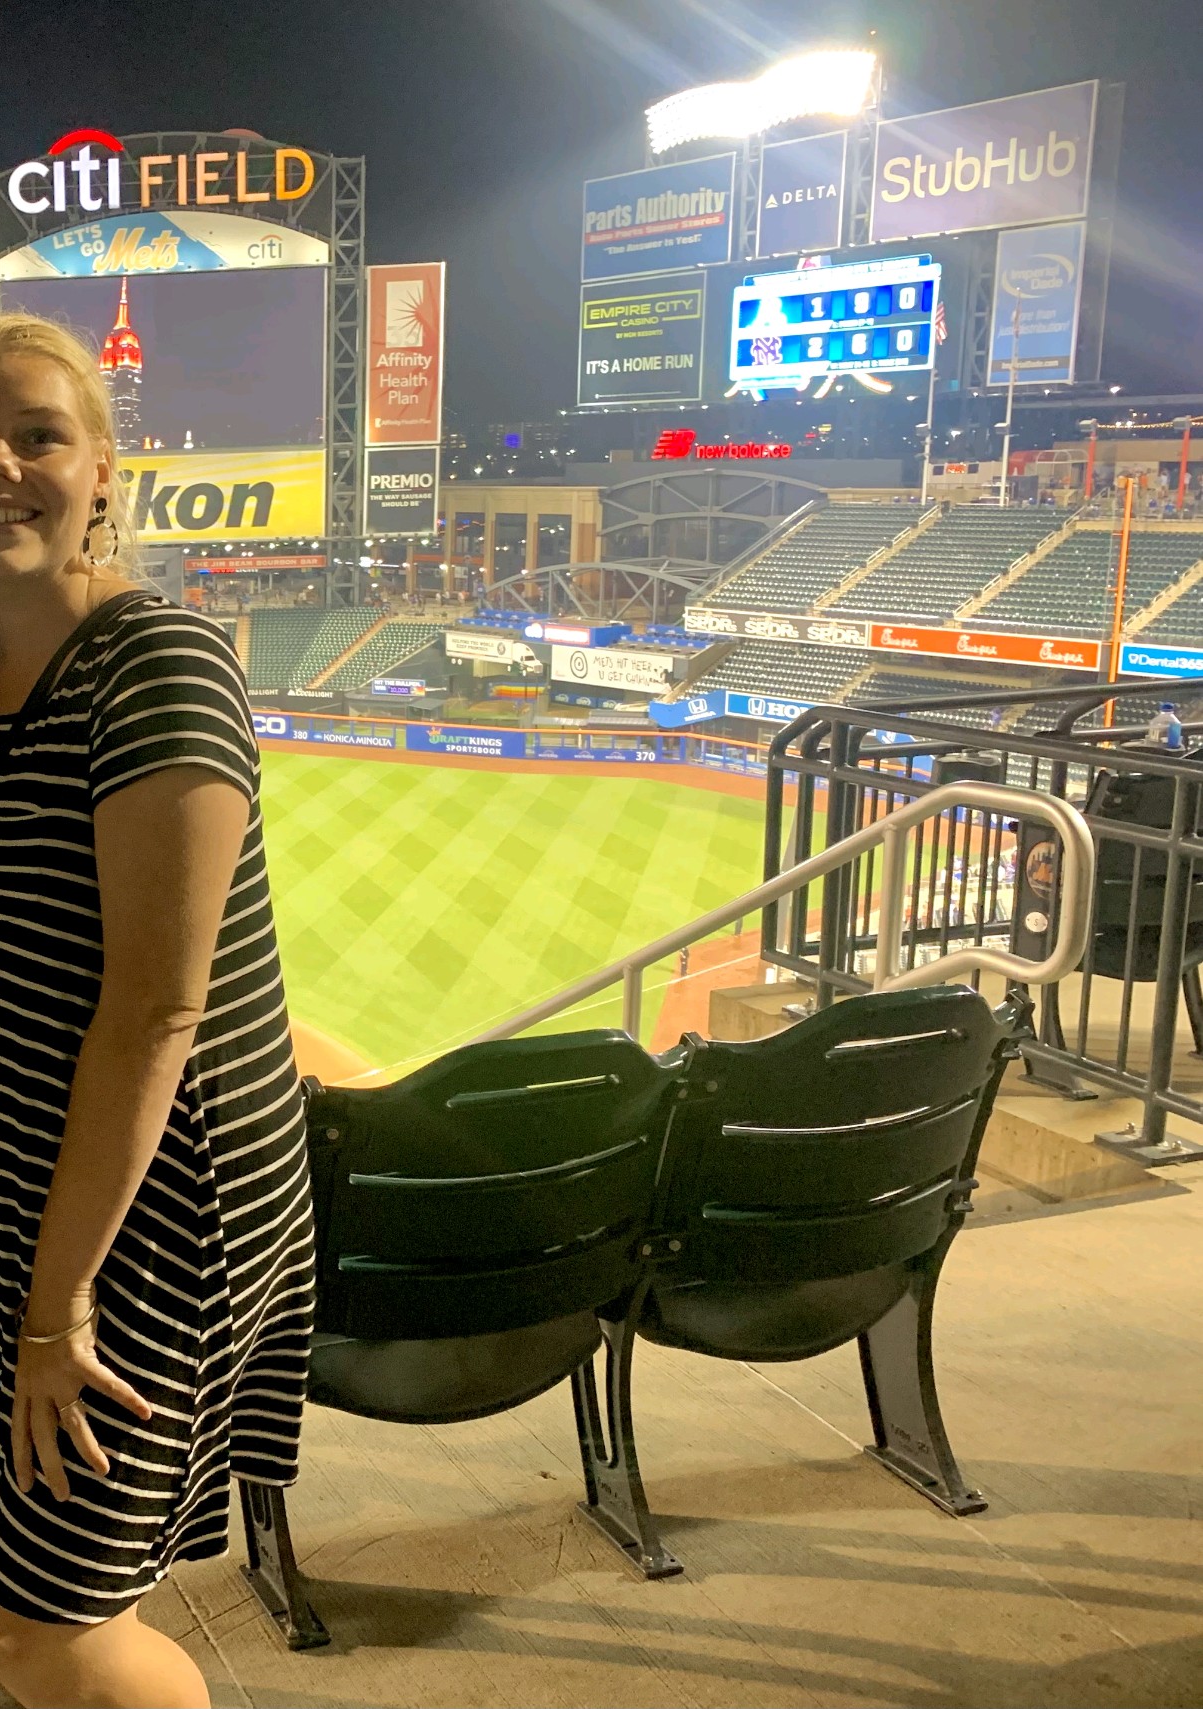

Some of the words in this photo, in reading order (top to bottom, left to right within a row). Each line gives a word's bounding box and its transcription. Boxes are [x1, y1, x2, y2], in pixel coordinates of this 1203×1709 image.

[881, 131, 1076, 203] StubHub
[8, 145, 120, 214] citi
[140, 148, 315, 208] FIELD
[782, 184, 837, 205] DELTA
[585, 204, 632, 233] Parts
[635, 187, 726, 225] Authority
[53, 224, 102, 250] LET'S
[80, 241, 105, 258] GO
[93, 227, 181, 272] Mets
[247, 236, 283, 259] citi
[590, 303, 652, 320] EMPIRE
[655, 299, 694, 313] CITY
[810, 297, 825, 318] 1
[899, 286, 916, 310] 0
[621, 316, 660, 327] CASINO
[896, 329, 913, 352] 0
[376, 352, 433, 370] Affinity
[586, 359, 609, 375] IT'S
[611, 359, 621, 373] A
[623, 356, 662, 372] HOME
[665, 354, 694, 369] RUN
[380, 373, 428, 388] Health
[388, 390, 419, 405] Plan
[696, 444, 726, 459] new
[728, 441, 792, 459] balance
[370, 473, 433, 489] PREMIO
[593, 655, 614, 669] METS
[1139, 653, 1203, 670] Dental365
[766, 702, 807, 718] HO
[292, 730, 308, 740] 380
[323, 733, 356, 744] KONICA
[356, 735, 393, 747] MINOLTA
[428, 733, 503, 747] DRAFTKINGS
[445, 744, 502, 755] SPORTSBOOK
[635, 751, 656, 762] 370
